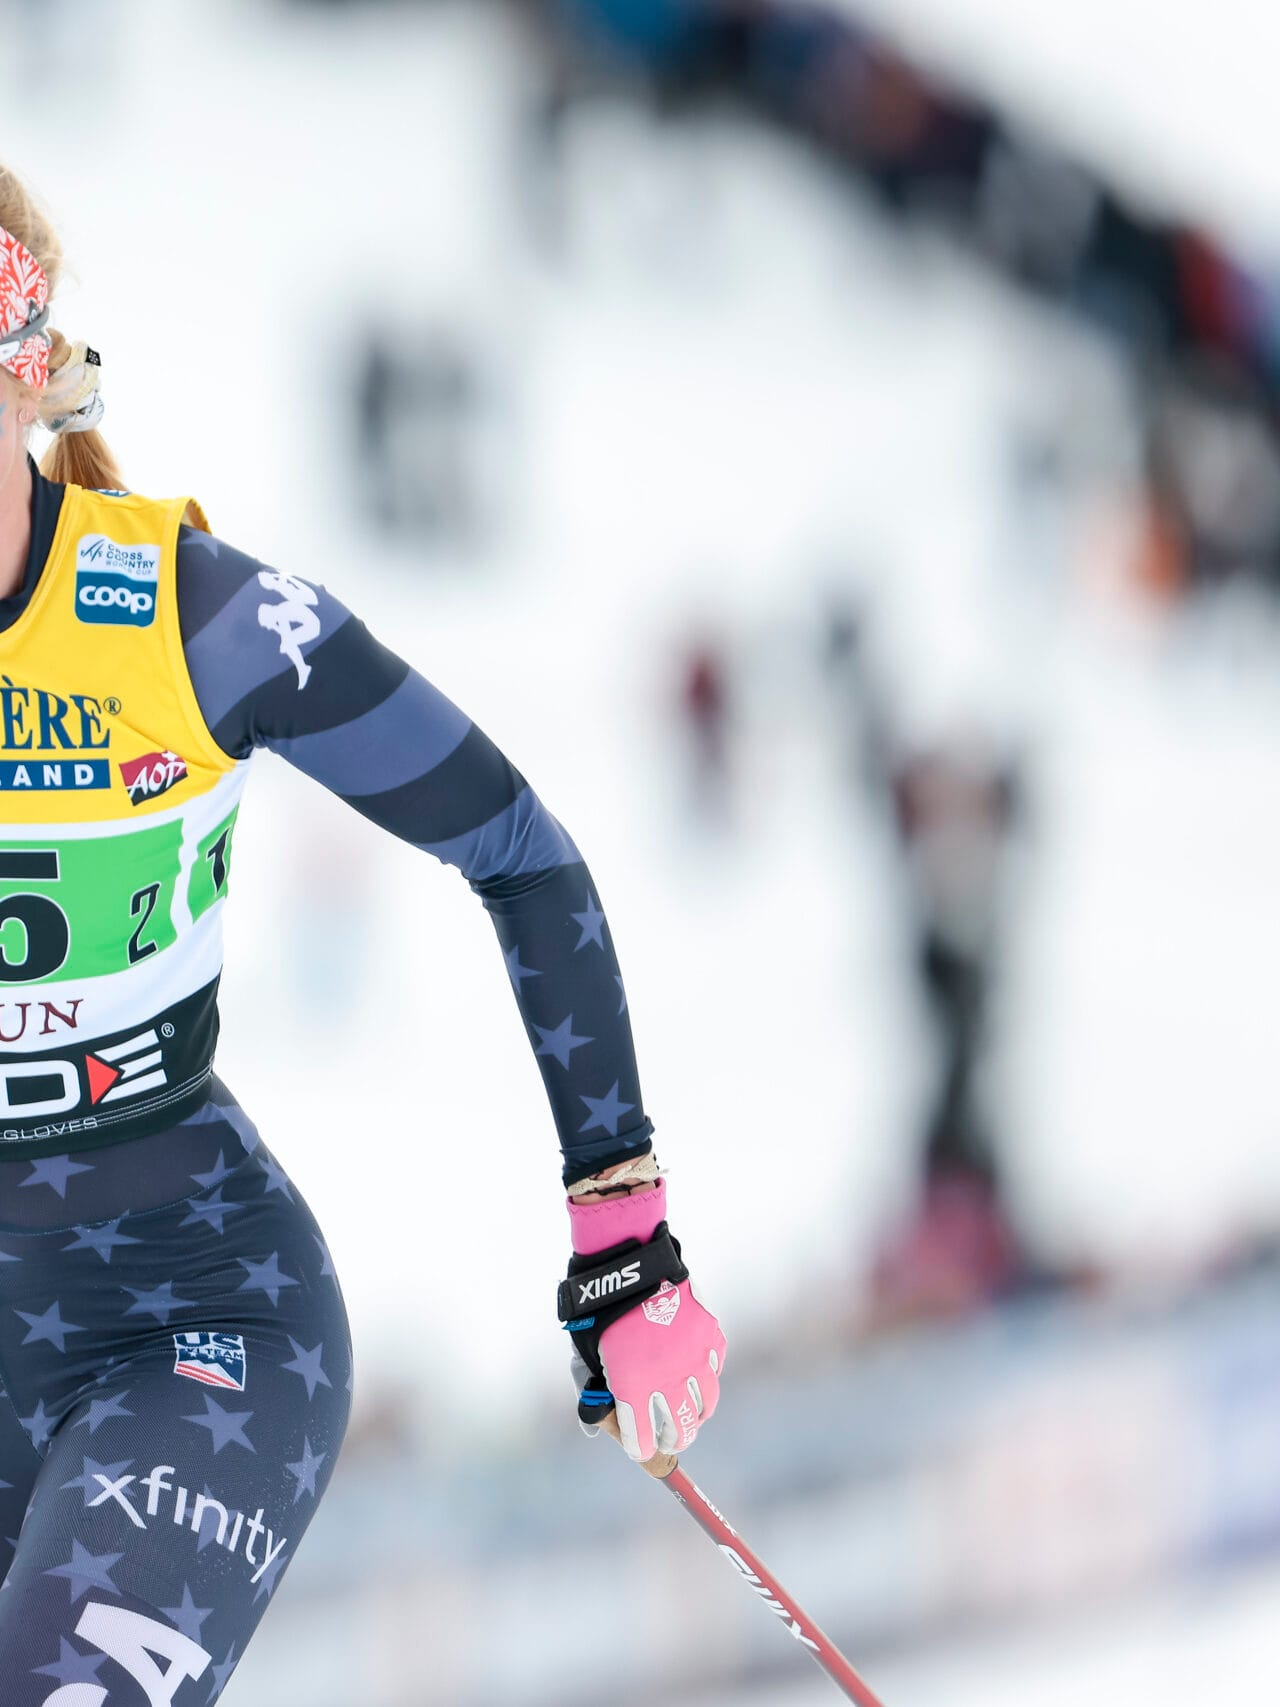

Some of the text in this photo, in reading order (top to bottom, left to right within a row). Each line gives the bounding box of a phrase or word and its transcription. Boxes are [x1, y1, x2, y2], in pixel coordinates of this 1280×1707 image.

[78, 585, 153, 615] coop
[125, 760, 187, 798] AOP
[127, 881, 161, 966] 2
[3, 1117, 99, 1141] GLOVES
[578, 1260, 642, 1305] SWIX
[175, 1331, 243, 1351] US
[87, 1465, 287, 1584] xfinity
